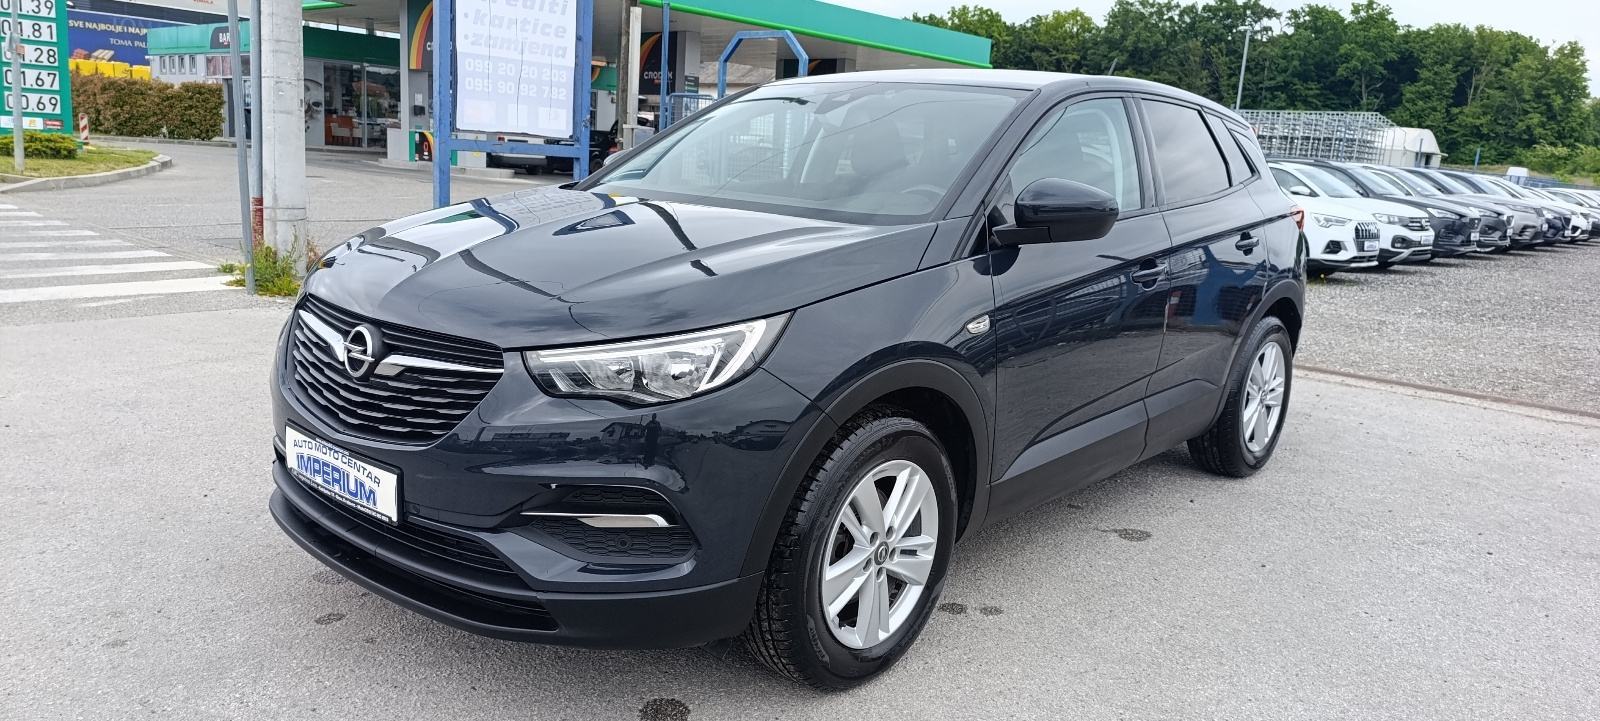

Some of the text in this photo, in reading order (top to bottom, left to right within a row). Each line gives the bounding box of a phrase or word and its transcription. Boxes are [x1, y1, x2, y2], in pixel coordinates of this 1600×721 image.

[2, 19, 53, 40] 01.81
[68, 20, 84, 29] SVE
[85, 21, 124, 33] NAJBOLJE
[473, 8, 567, 38] kartice
[109, 38, 149, 48] TOMA PAL
[470, 32, 568, 58] zamjena
[5, 69, 57, 88] 01.67
[497, 62, 516, 76] 20
[521, 65, 538, 79] 20
[541, 67, 567, 83] 203
[497, 80, 515, 95] 90
[520, 83, 538, 97] 92
[7, 93, 58, 112] 00.69
[293, 439, 313, 451] AUTO
[314, 442, 340, 461] MOTO
[341, 454, 381, 488] CENTAR
[296, 452, 379, 509] IMPERIUM
